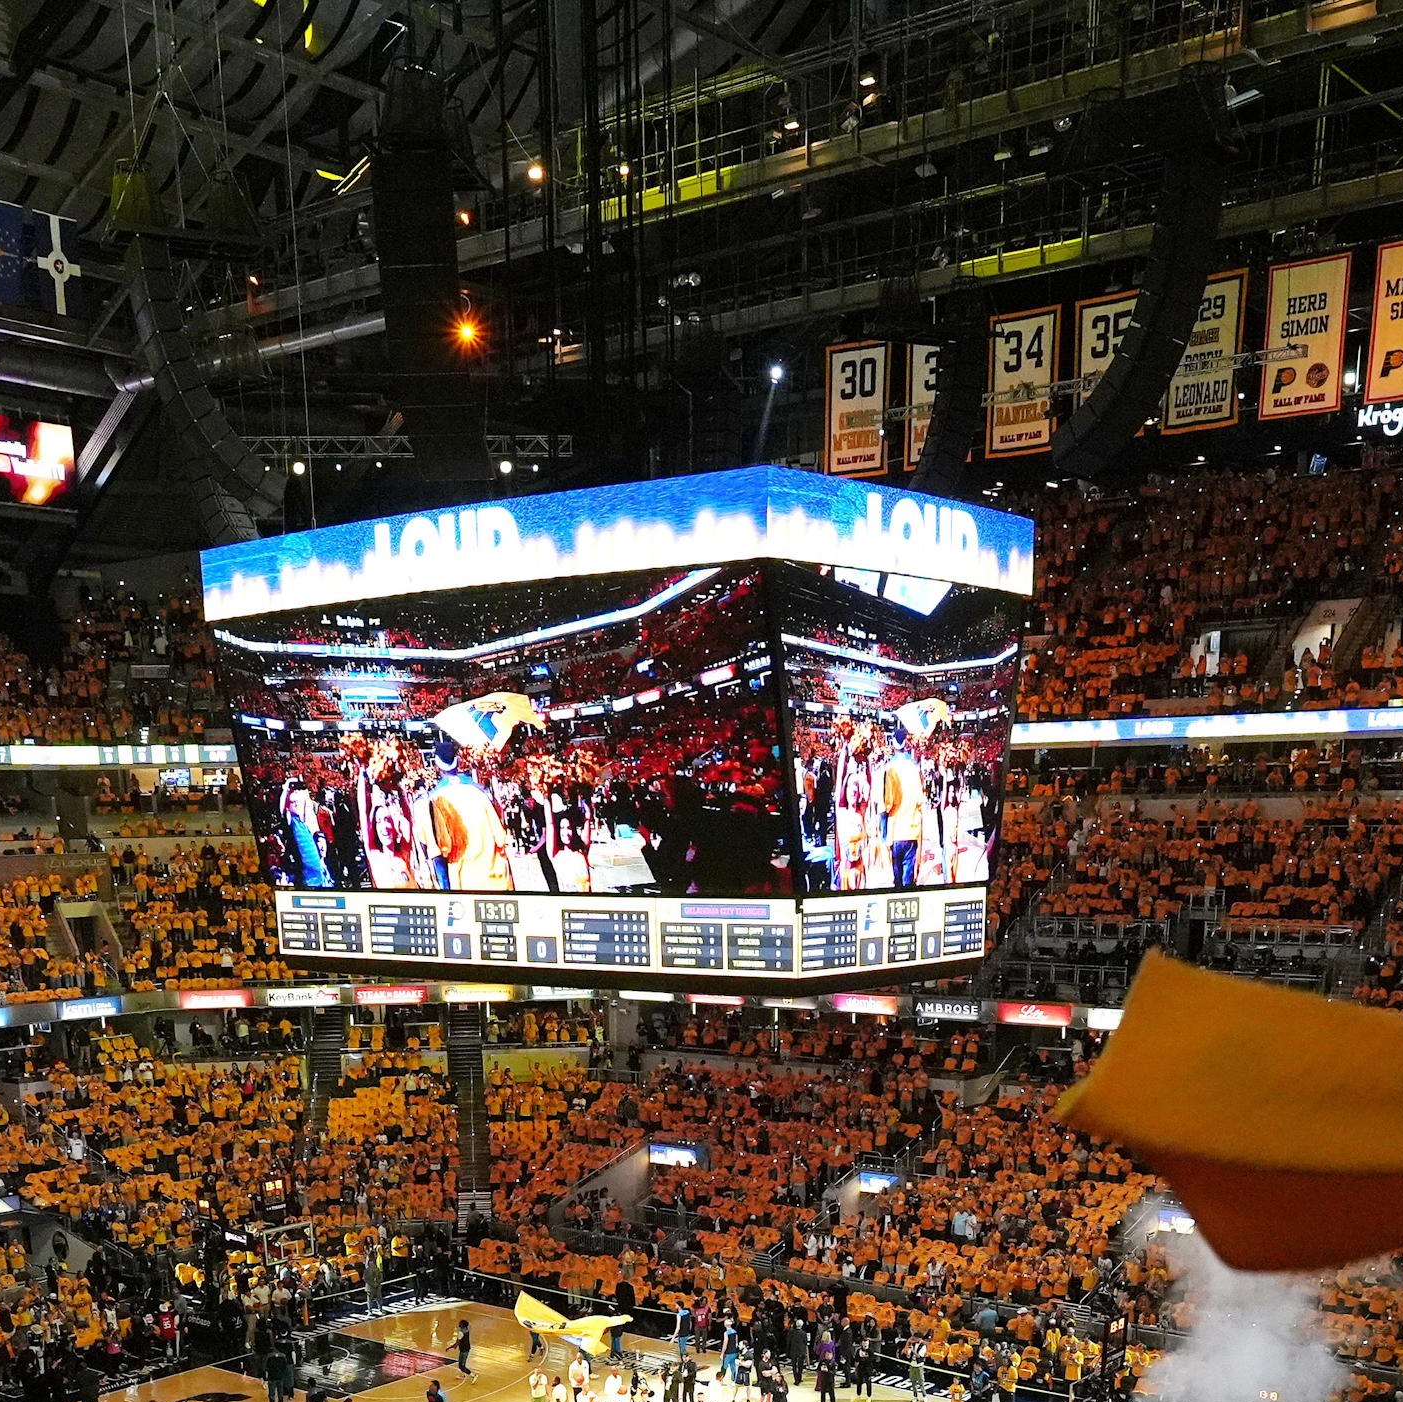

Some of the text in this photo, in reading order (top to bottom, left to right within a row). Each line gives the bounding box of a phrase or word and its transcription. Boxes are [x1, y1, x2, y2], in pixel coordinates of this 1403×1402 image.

[1287, 292, 1327, 316] HERB
[1281, 315, 1330, 339] SIMON
[1004, 325, 1044, 373] 34
[840, 357, 877, 400] 30
[1174, 380, 1228, 408] LEONARD
[1273, 393, 1326, 409] HALL OF FAME
[1000, 433, 1015, 443] HALL
[1025, 430, 1042, 440] FAME
[1134, 721, 1174, 736] LOUD
[478, 902, 516, 921] 13:19
[889, 901, 918, 919] 13:19
[452, 937, 462, 955] 0
[536, 941, 547, 958] 0
[868, 943, 876, 960] 0
[927, 936, 936, 954] 0
[268, 991, 314, 1003] KeyBank
[356, 989, 424, 1000] STEAK SHAKE
[915, 1002, 979, 1015] AMBROSE
